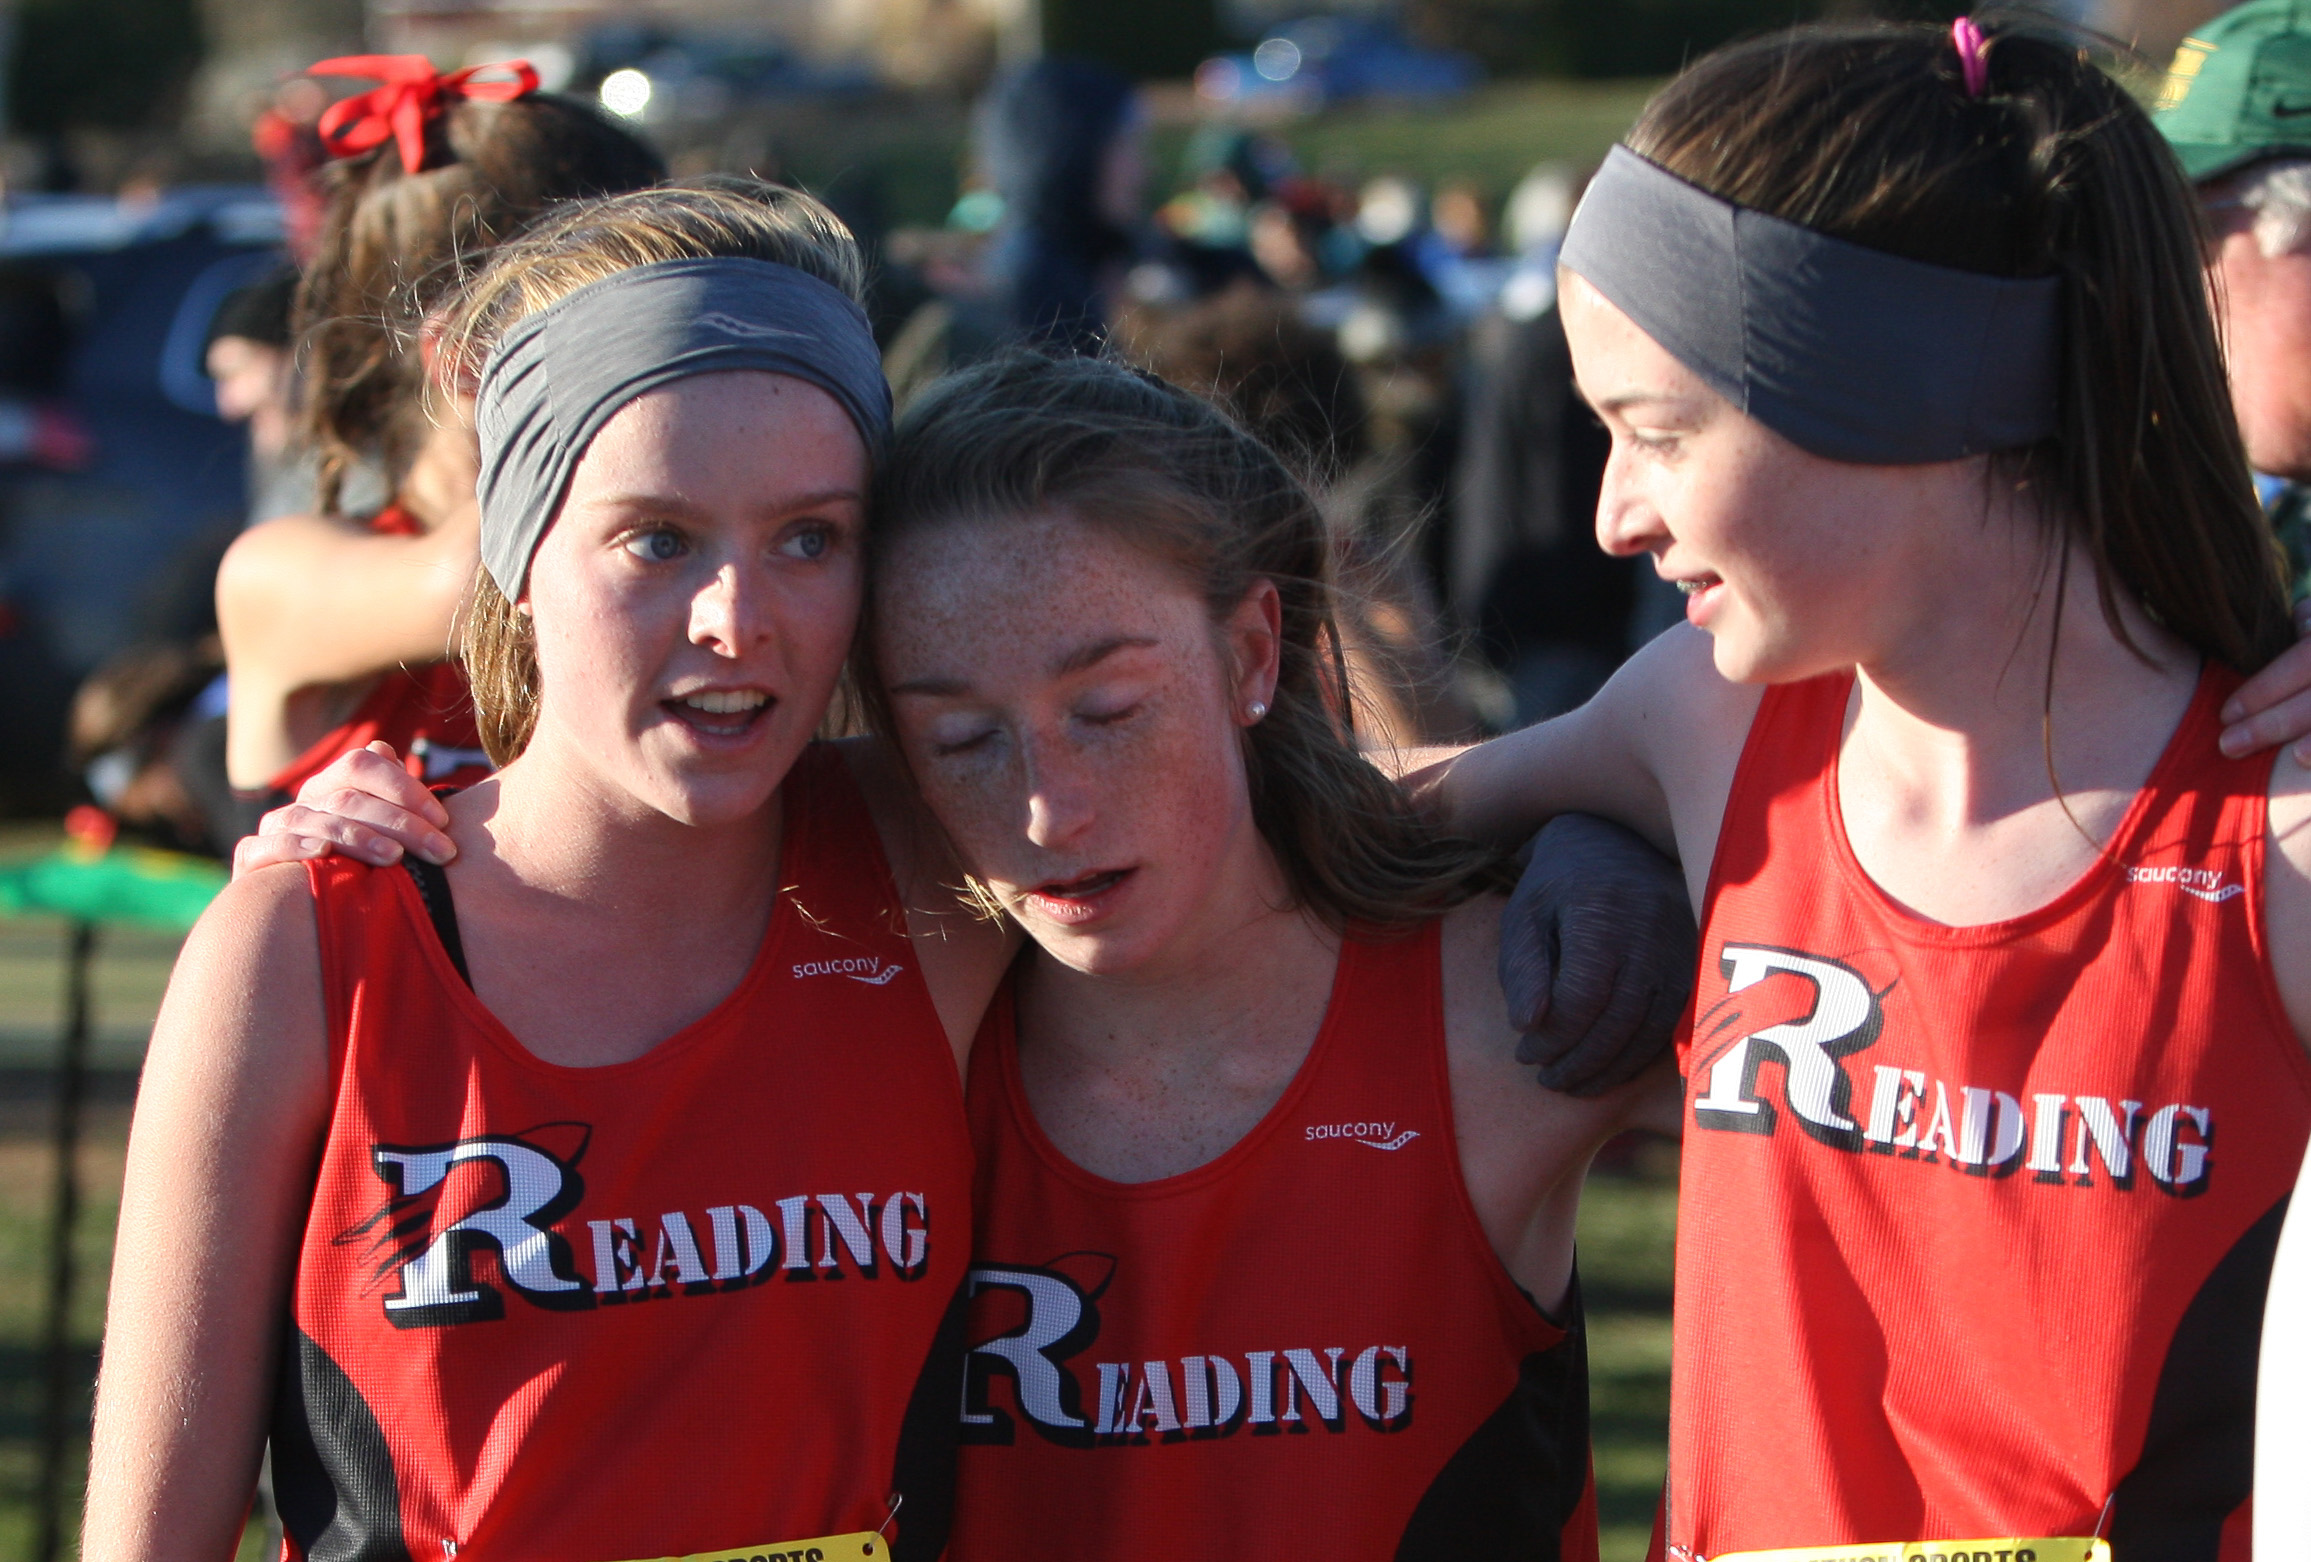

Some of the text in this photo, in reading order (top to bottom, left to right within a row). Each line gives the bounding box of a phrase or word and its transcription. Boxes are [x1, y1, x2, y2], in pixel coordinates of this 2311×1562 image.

[2127, 866, 2222, 890] saucony
[792, 956, 879, 979] saucony
[1694, 943, 2213, 1195] READING
[1305, 1121, 1395, 1141] saucony
[371, 1134, 930, 1325] READING
[959, 1263, 1412, 1440] READING
